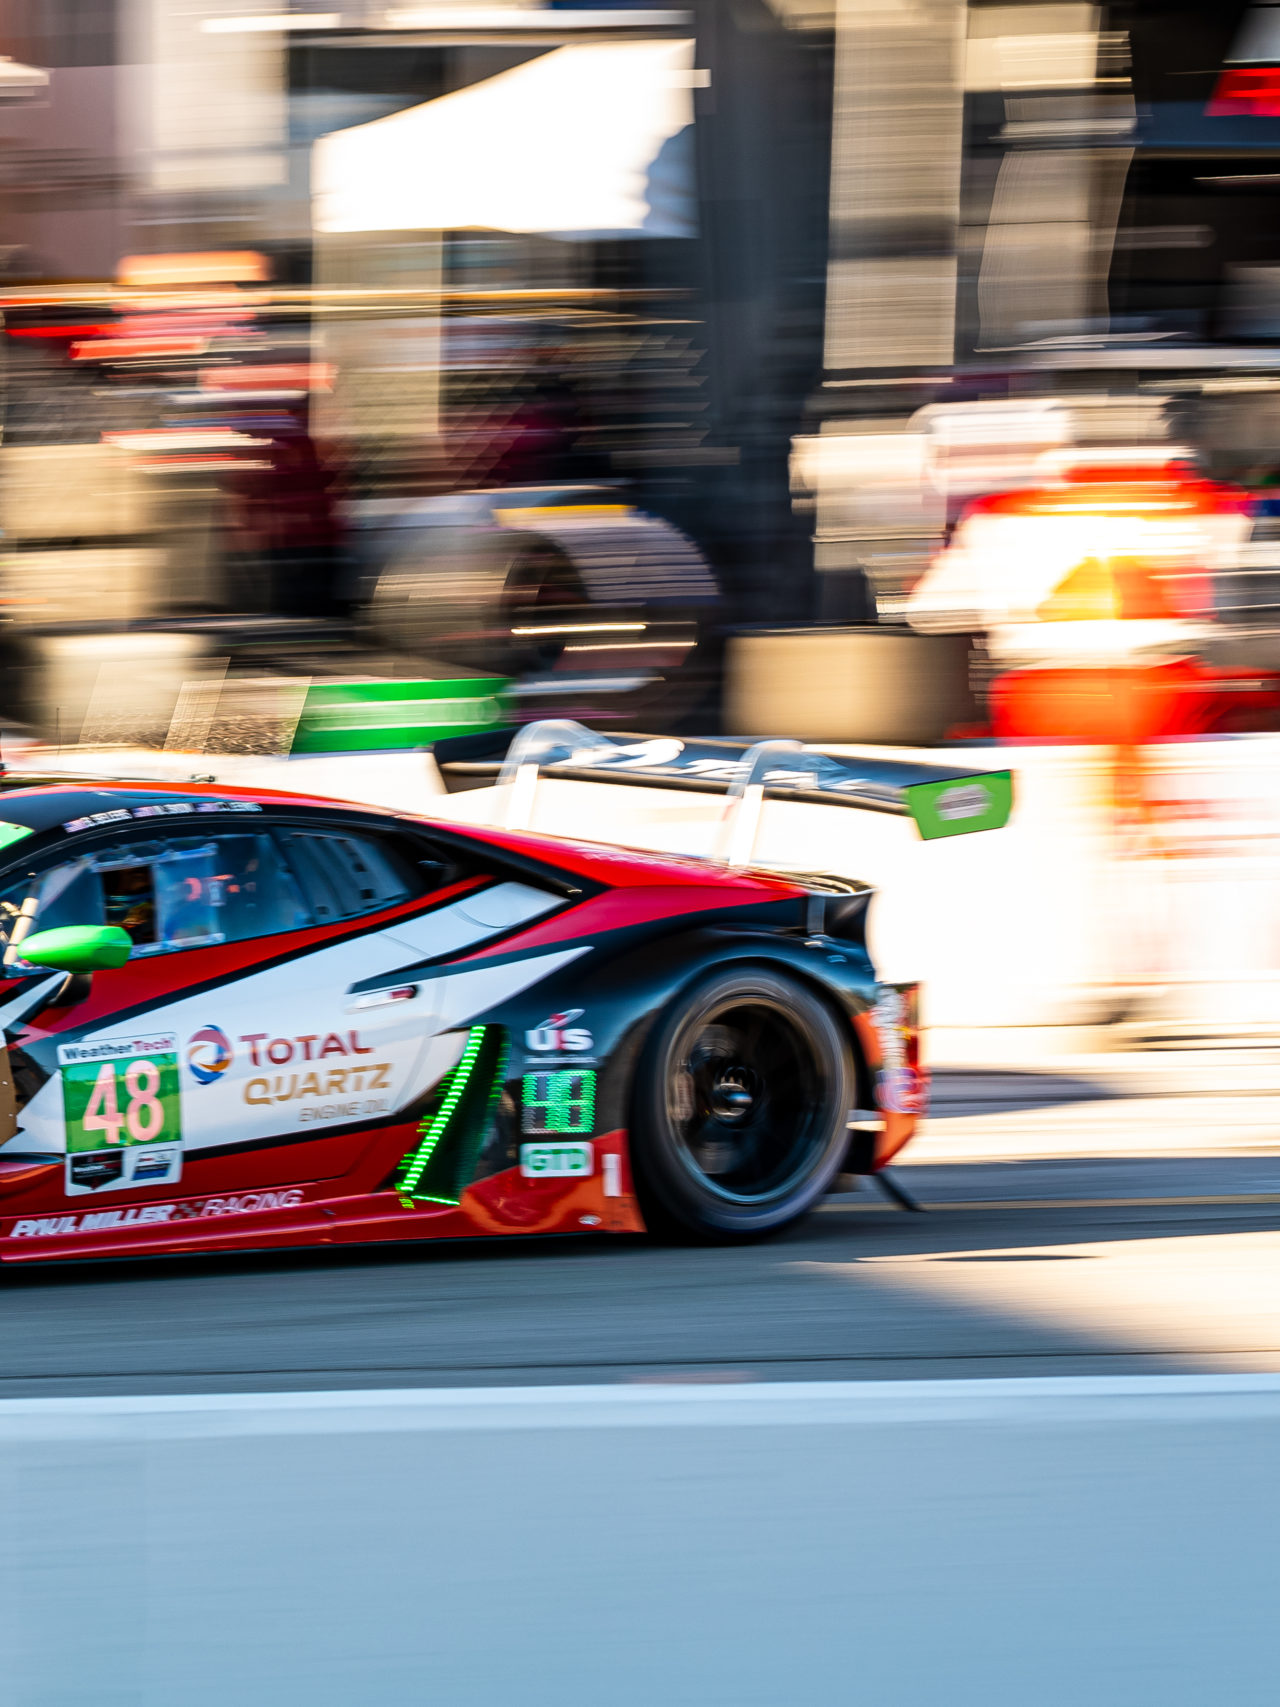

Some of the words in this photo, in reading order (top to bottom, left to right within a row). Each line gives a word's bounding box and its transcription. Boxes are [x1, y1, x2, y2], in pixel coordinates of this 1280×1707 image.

[63, 1038, 173, 1059] WeatherTech
[239, 1029, 375, 1067] TOTAL
[82, 1060, 164, 1144] 48
[243, 1063, 392, 1105] QUARTZ
[521, 1069, 597, 1133] 48
[299, 1101, 360, 1122] ENGINE
[10, 1215, 77, 1237] PAUL
[79, 1205, 176, 1231] MILLER
[201, 1190, 304, 1216] RACING
